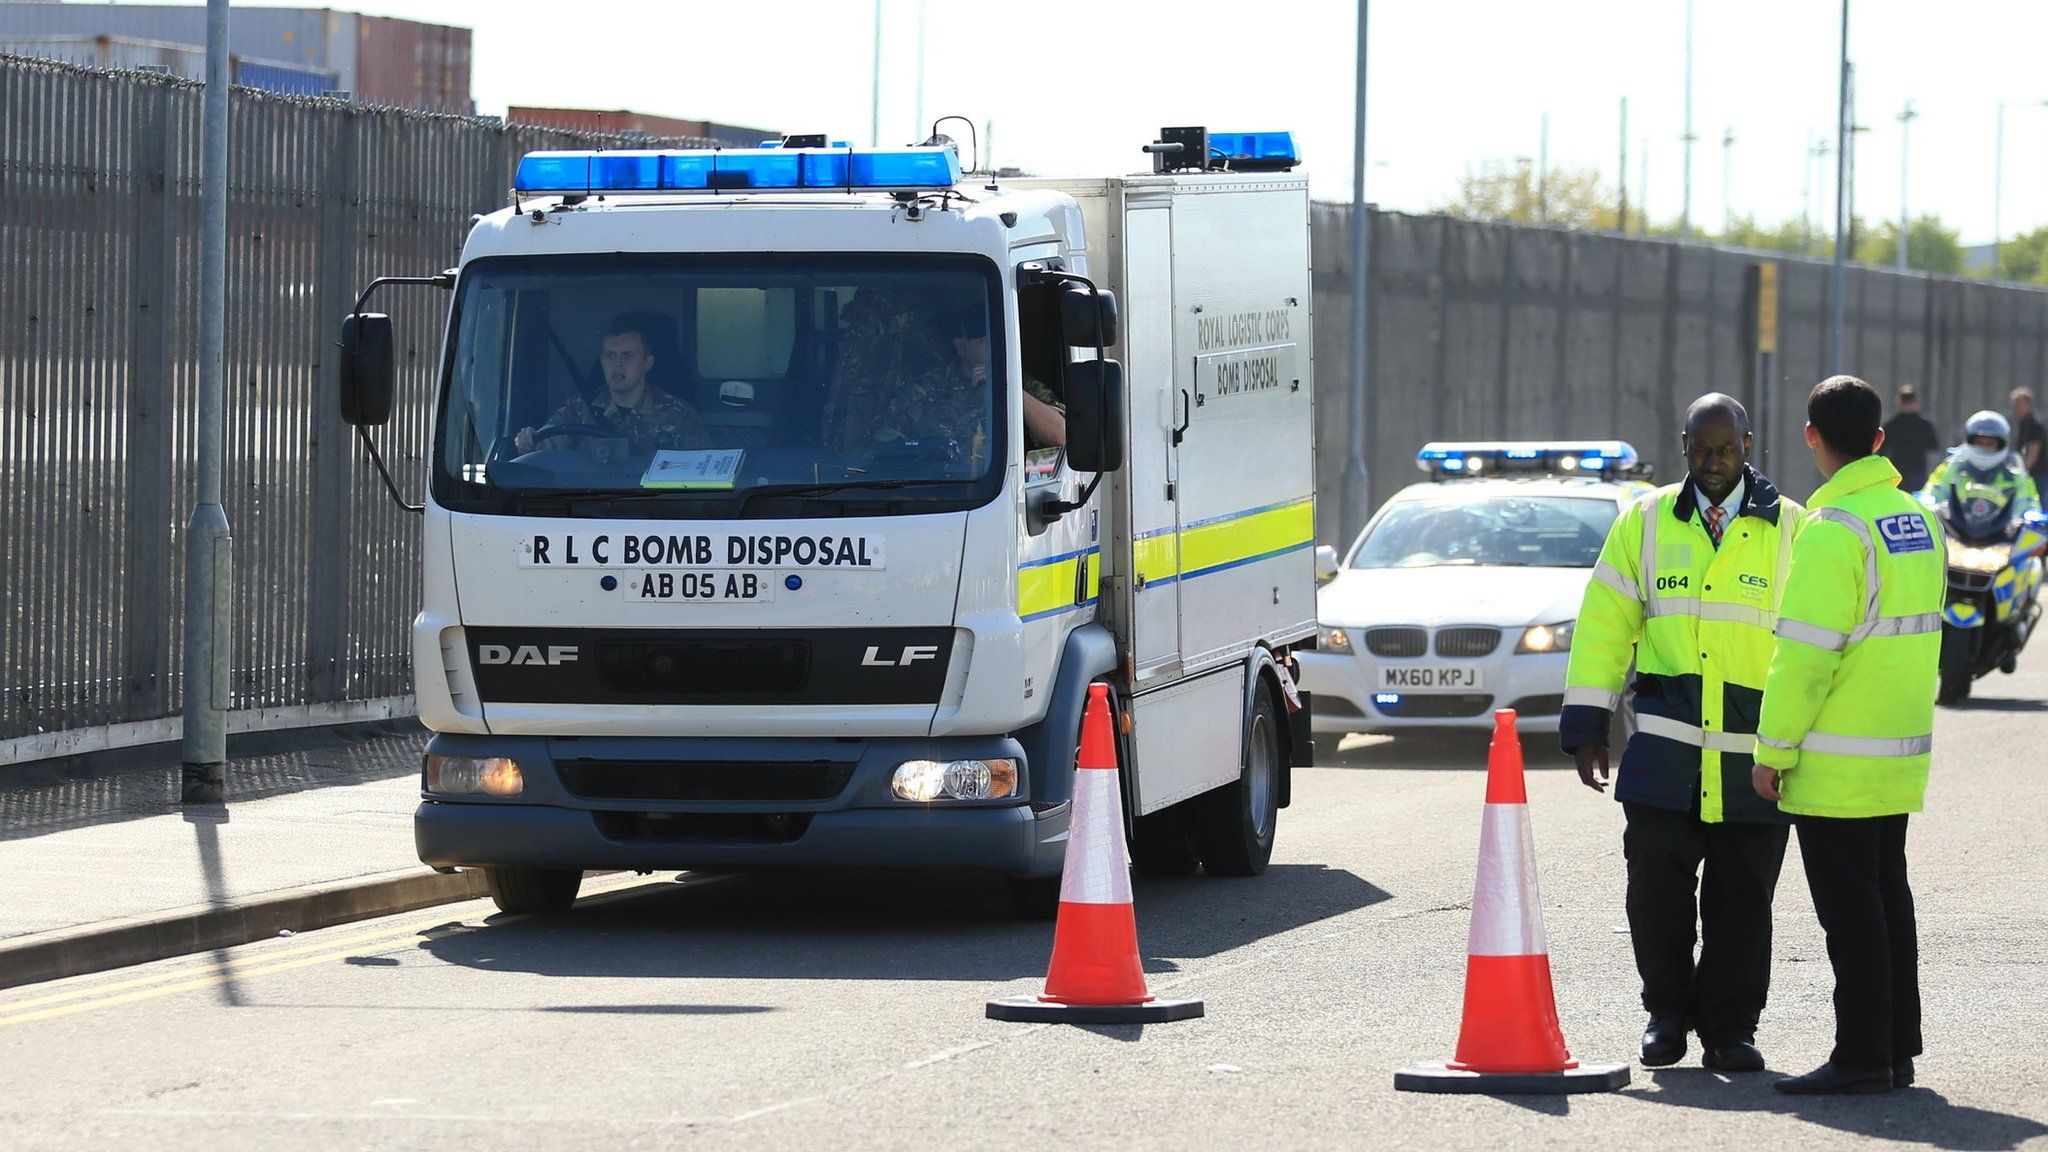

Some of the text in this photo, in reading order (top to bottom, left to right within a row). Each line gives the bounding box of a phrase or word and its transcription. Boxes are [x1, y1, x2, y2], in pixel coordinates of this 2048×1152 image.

[1198, 309, 1289, 350] ROYAL LOGISTIC CORPS
[1217, 356, 1277, 395] BOMB DISPOSAL
[1881, 515, 1929, 541] CES
[533, 536, 871, 566] R L C BOMB DISPOSAL
[641, 573, 758, 598] AB 05 AB
[1656, 575, 1689, 590] 064
[1738, 573, 1769, 588] CES
[479, 645, 578, 666] DAF
[861, 645, 938, 666] LF
[1386, 669, 1475, 686] MX60 KPJ
